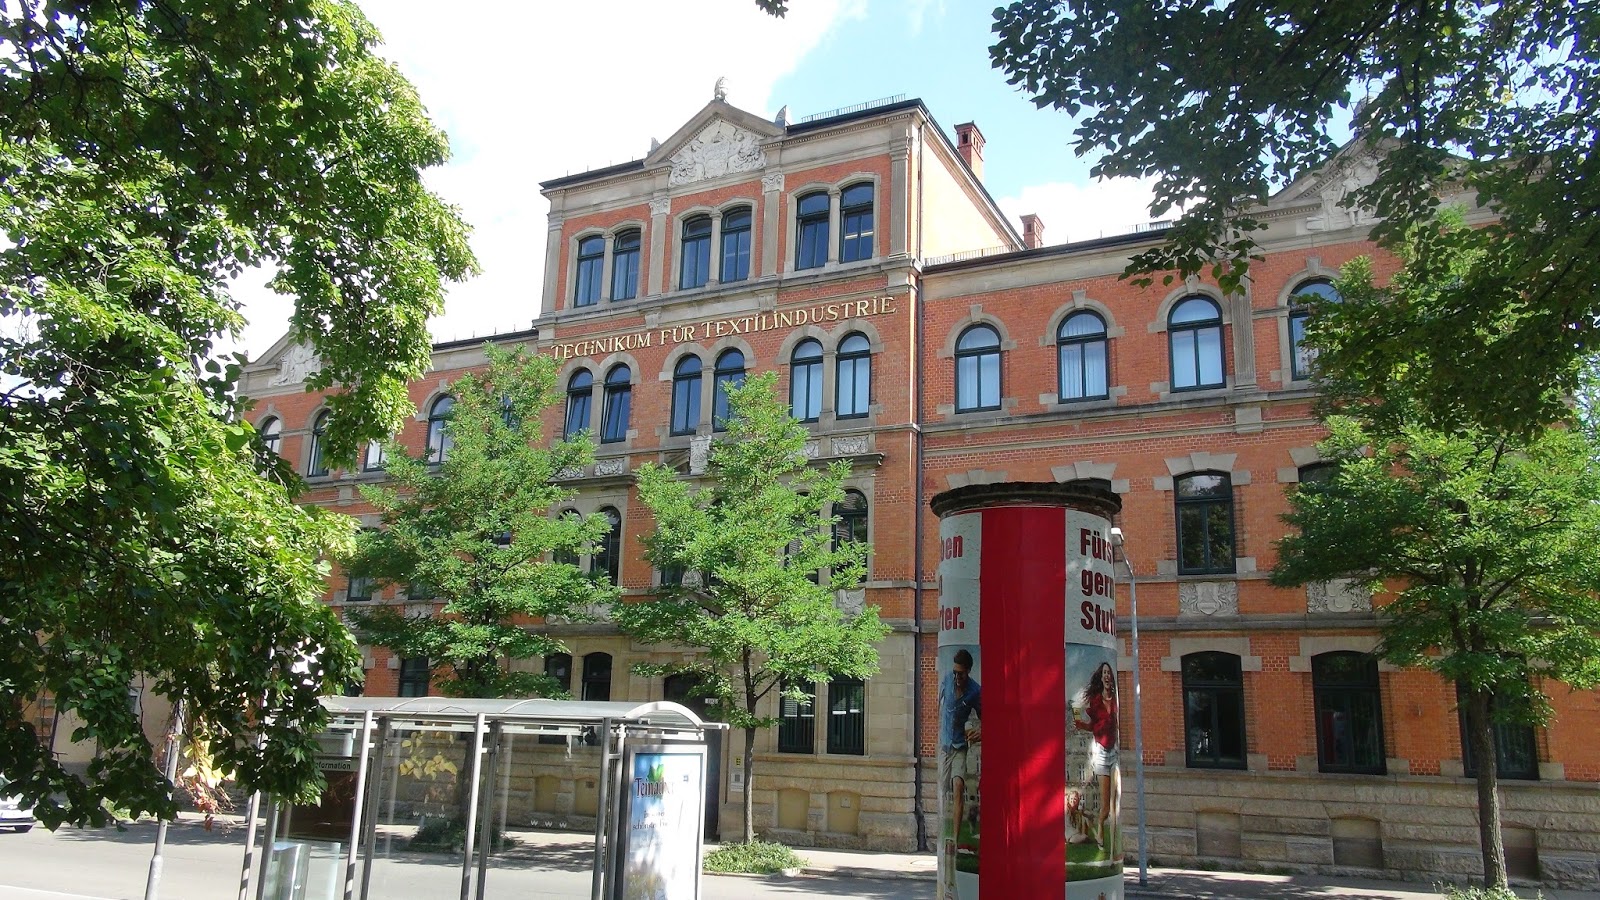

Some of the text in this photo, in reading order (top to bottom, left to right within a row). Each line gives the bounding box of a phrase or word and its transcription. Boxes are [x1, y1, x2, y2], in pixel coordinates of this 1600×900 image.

[551, 296, 897, 360] TECHNIKUM FÜR TEXTILINDUSTRIE
